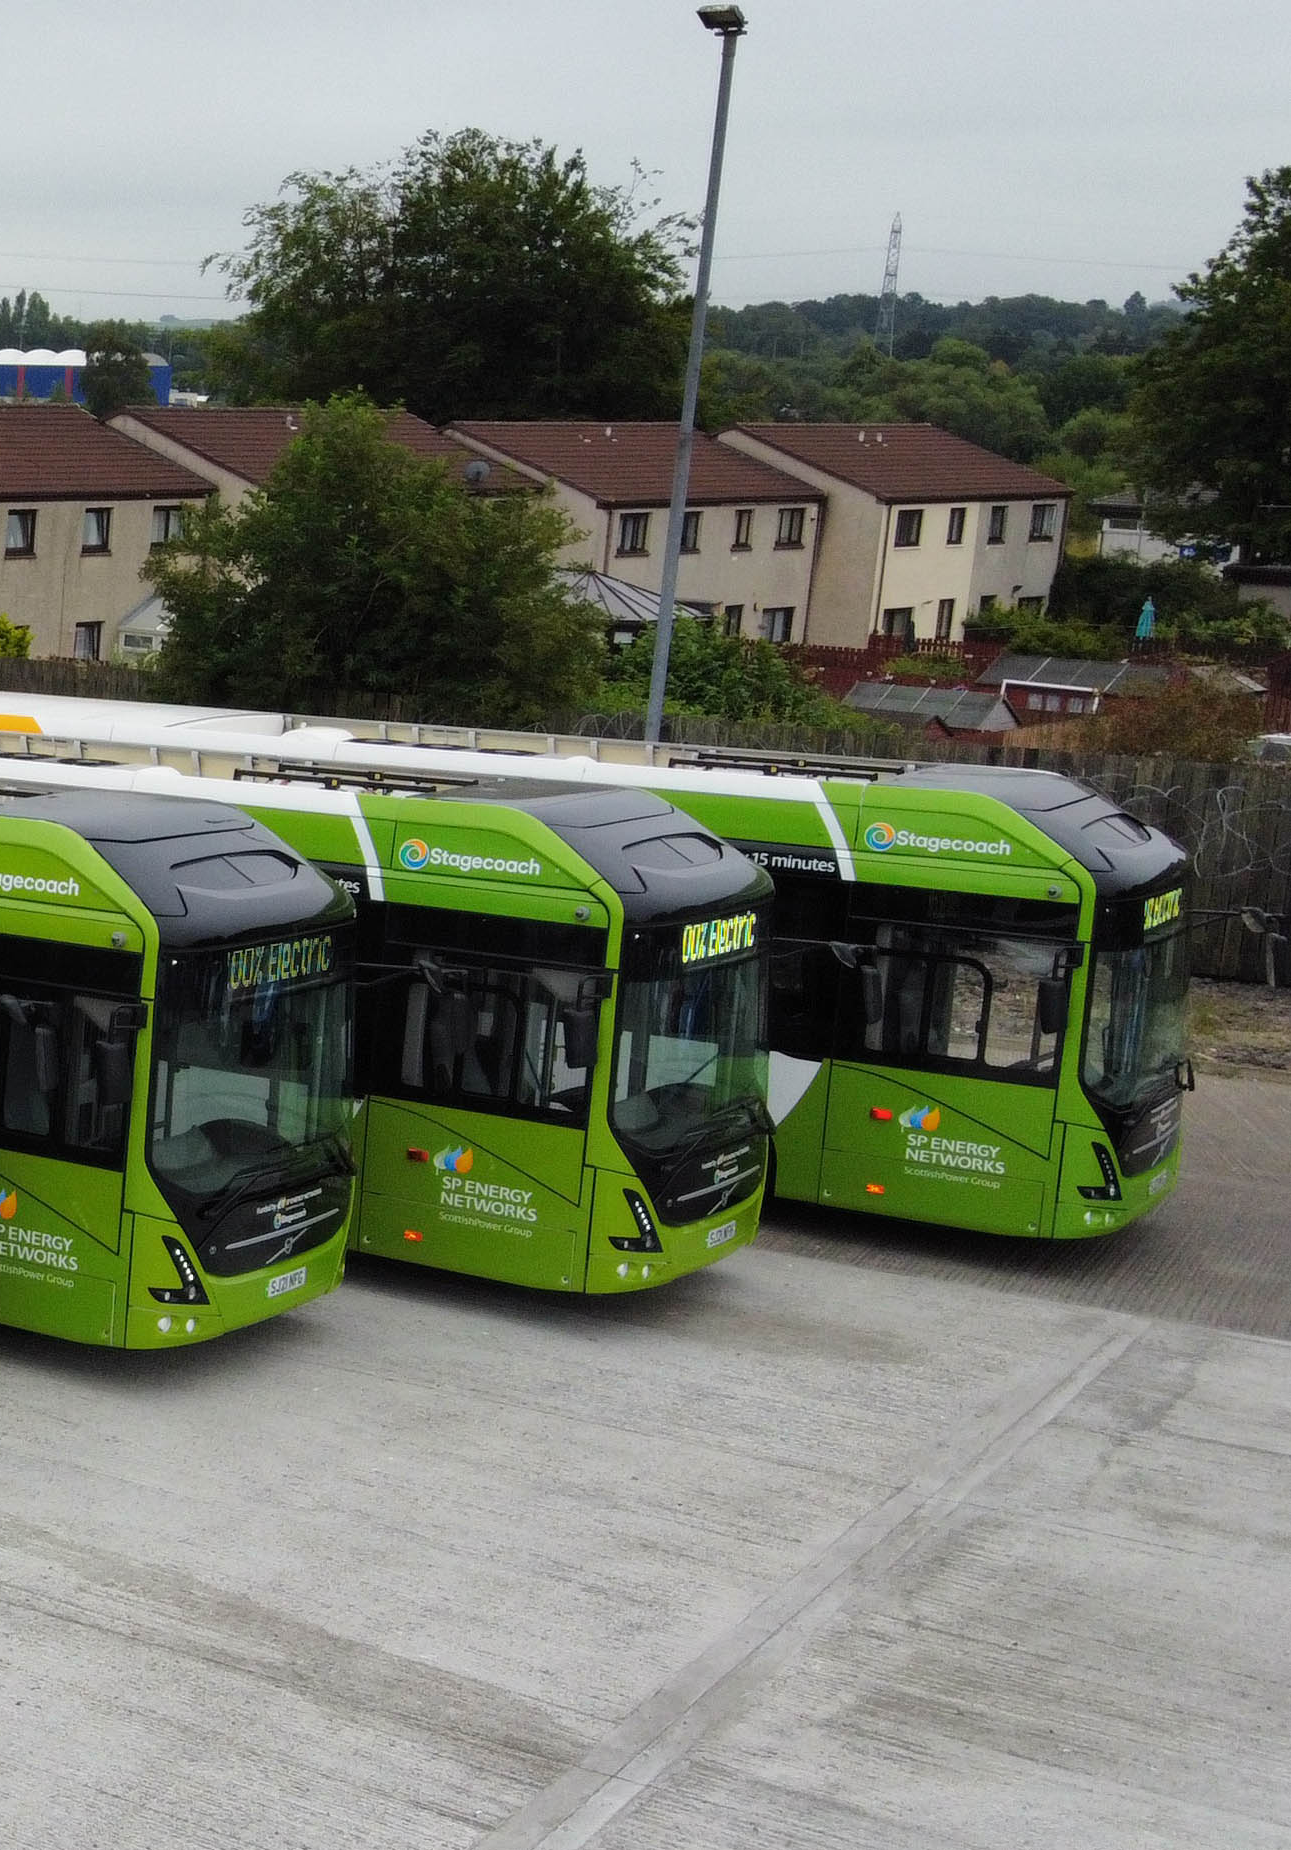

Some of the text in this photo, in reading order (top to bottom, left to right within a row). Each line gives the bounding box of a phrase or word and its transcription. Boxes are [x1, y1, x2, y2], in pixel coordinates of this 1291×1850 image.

[895, 830, 1011, 855] Stagecoach
[429, 848, 540, 876] Stagecoach
[754, 852, 836, 873] 15 minutes
[907, 1134, 1001, 1158] SP ENERGY
[905, 1148, 1005, 1175] NETWORKS
[442, 1176, 532, 1204] SP ENERGY
[904, 1166, 1000, 1190] ScottishPower Group
[440, 1191, 538, 1222] NETWORKS
[439, 1211, 532, 1239] ScottishPower Group
[8, 1226, 73, 1252] ENERGY
[46, 1273, 74, 1288] Group
